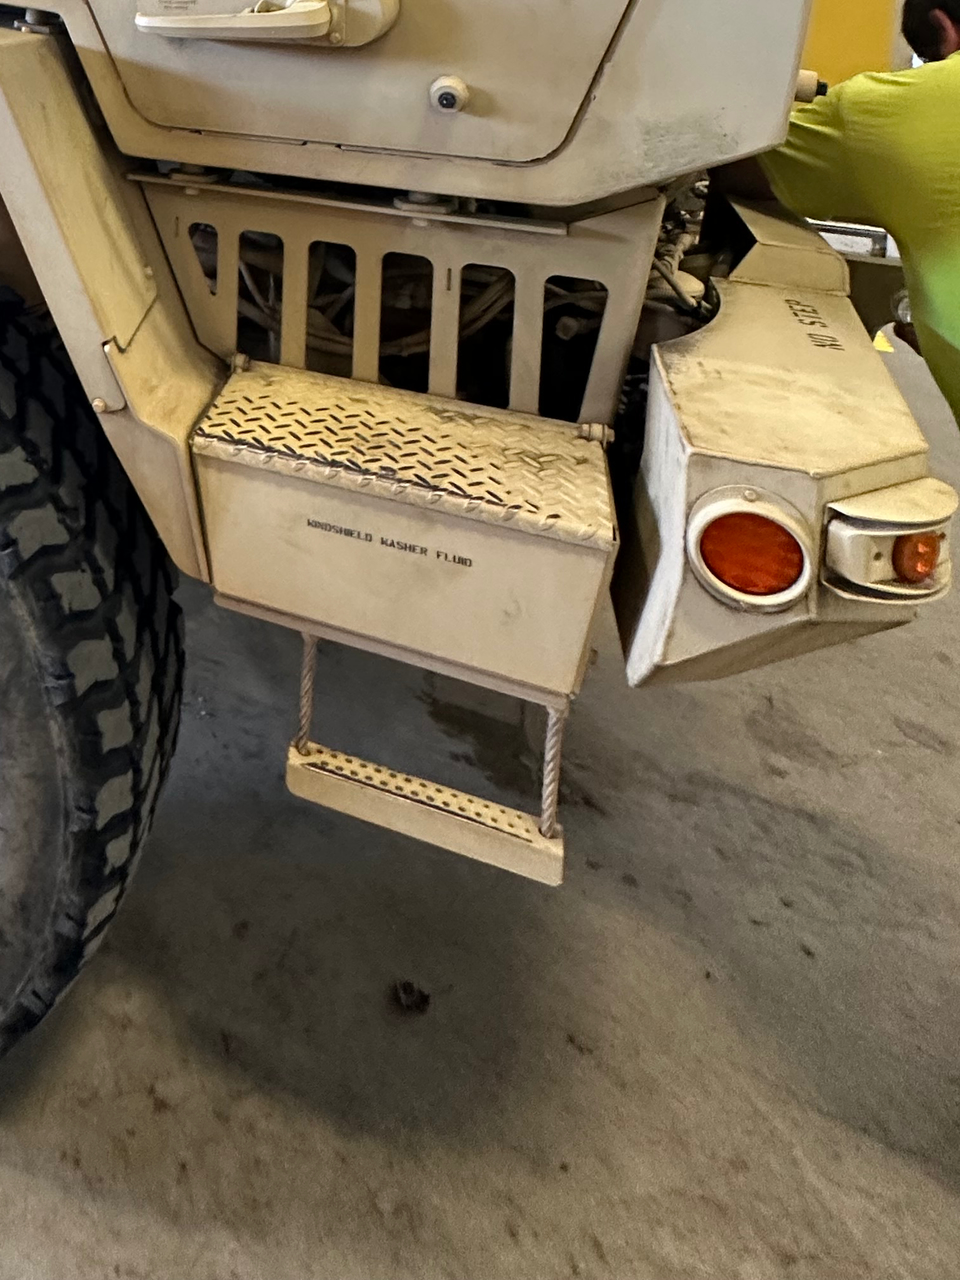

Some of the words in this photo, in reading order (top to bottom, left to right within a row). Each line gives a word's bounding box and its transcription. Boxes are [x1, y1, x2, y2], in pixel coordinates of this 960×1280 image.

[784, 299, 828, 328] STEP
[805, 333, 845, 351] NO
[307, 518, 373, 542] WINDSHIELD
[380, 537, 428, 556] WASHER
[436, 550, 473, 568] FLUID
